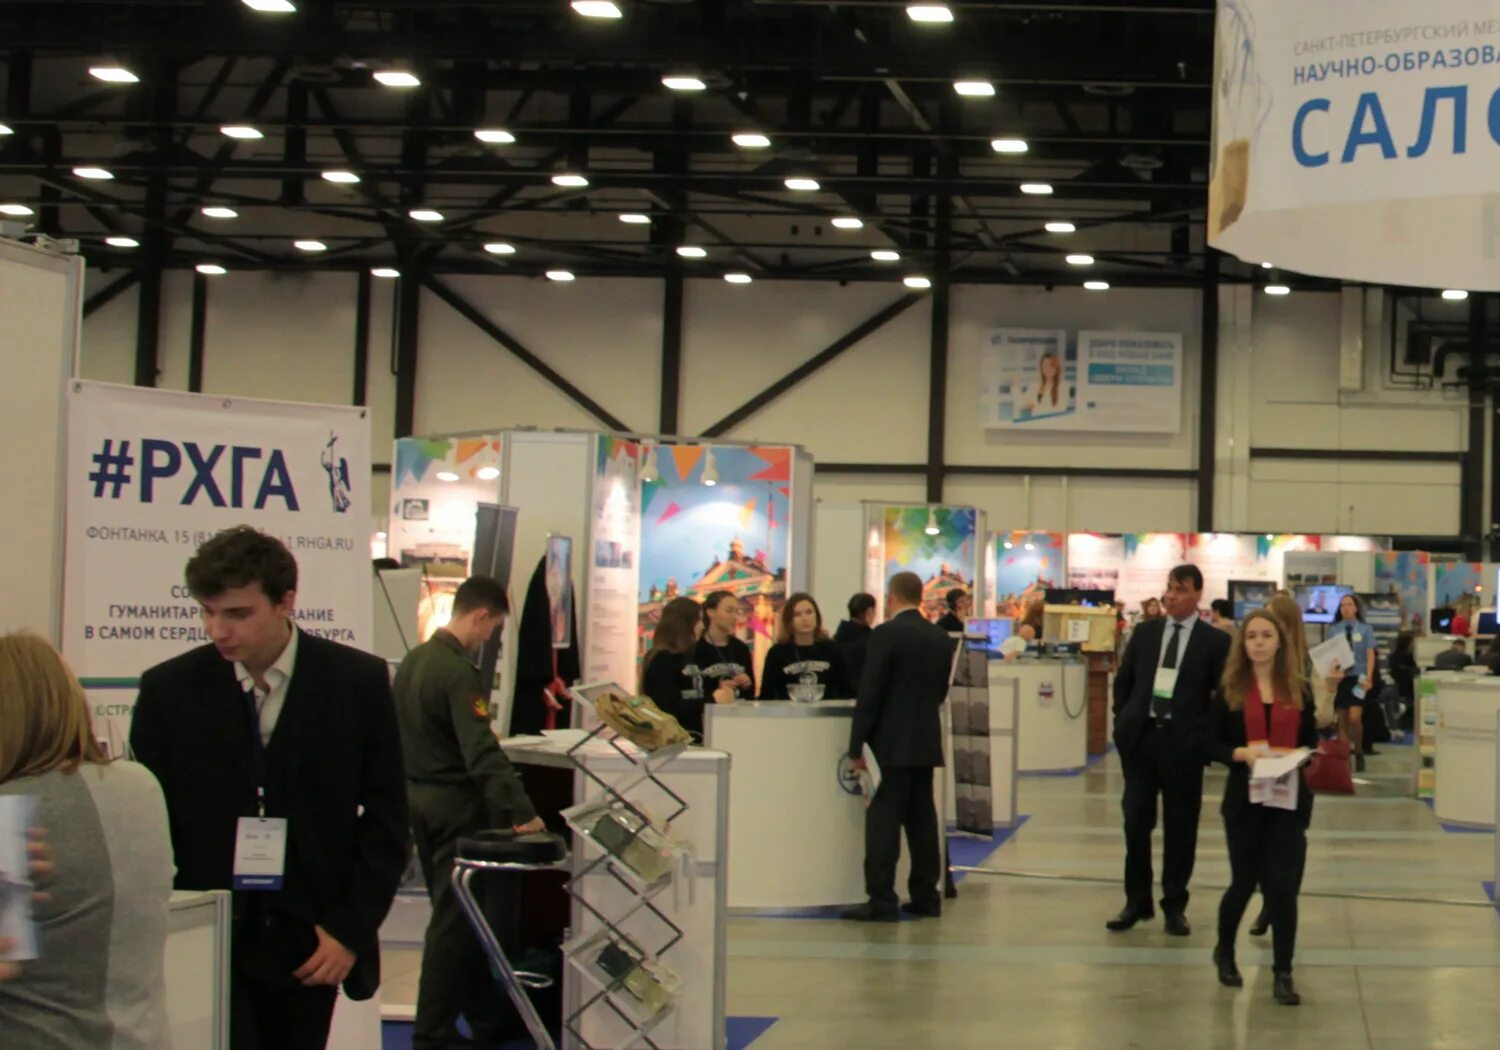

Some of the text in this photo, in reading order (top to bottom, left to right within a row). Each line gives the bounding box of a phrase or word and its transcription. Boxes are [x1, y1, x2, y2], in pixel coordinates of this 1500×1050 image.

[1294, 22, 1468, 56] САНКТ-ПЕТЕРБУРГСКИЙ
[88, 438, 300, 511] #РХГА
[173, 529, 190, 544] 15
[109, 604, 206, 620] ГУМАНИТАР
[84, 626, 94, 639] В
[99, 626, 155, 640] САМОМ
[160, 627, 209, 642] СЕРДЦ
